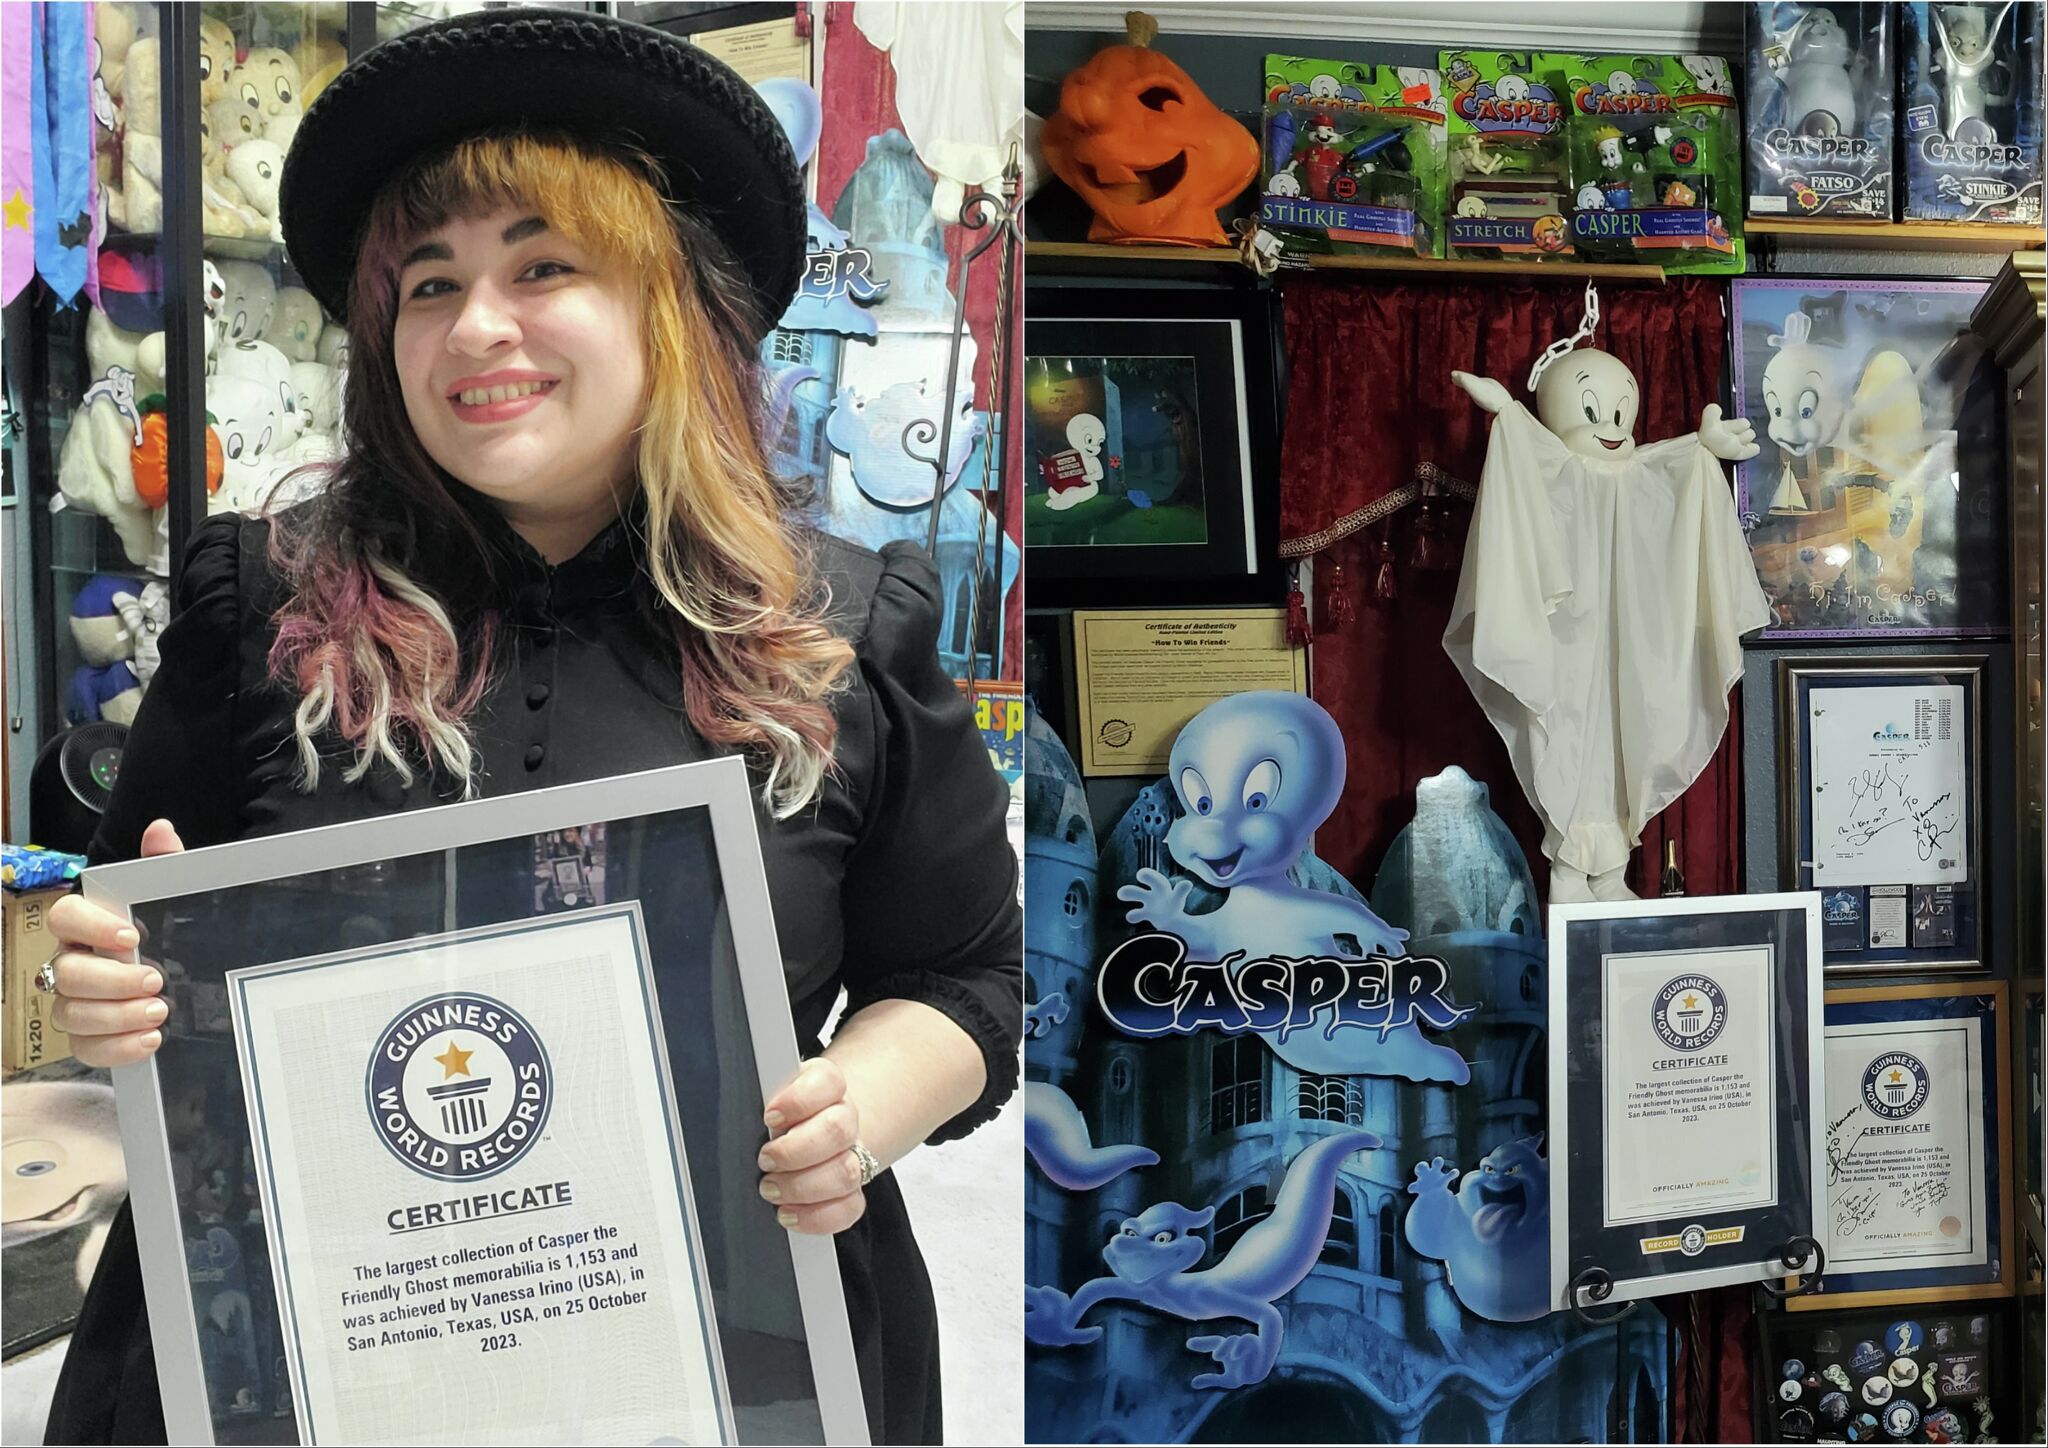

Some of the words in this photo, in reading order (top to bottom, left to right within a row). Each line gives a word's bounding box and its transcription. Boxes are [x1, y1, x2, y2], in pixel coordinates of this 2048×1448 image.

[1454, 91, 1566, 123] CASPER
[1575, 88, 1679, 115] CASPER
[1765, 128, 1879, 165] CASPER
[1922, 133, 2032, 172] CASPER
[1811, 176, 1854, 189] FATSO
[1966, 183, 2008, 196] STINKIE
[1263, 203, 1348, 228] STINKIE
[1574, 213, 1648, 237] CASPER
[1455, 225, 1526, 239] STRETCH
[1193, 622, 1237, 630] Authenticity
[26, 903, 40, 929] 215
[1098, 930, 1482, 1045] CASPER
[1662, 978, 1718, 1001] GUINNESS
[386, 1003, 519, 1063] GUINNESS
[1656, 1009, 1682, 1046] WORLD
[1686, 1005, 1724, 1048] RECORDS
[29, 1019, 43, 1063] 1x20
[1652, 1055, 1729, 1070] CERTIFICATE
[1870, 1055, 1920, 1075] GUINNESS
[1628, 1090, 1654, 1100] Friendly
[1655, 1089, 1674, 1097] Ghost
[1675, 1086, 1713, 1096] memorabilia
[1721, 1083, 1738, 1091] 1,153
[1635, 1082, 1647, 1090] The
[1648, 1080, 1671, 1089] largest
[1672, 1077, 1703, 1086] collection
[1703, 1075, 1711, 1083] of
[1711, 1075, 1733, 1083] Casper
[1628, 1111, 1641, 1119] San
[1718, 1102, 1726, 1110] 25
[1727, 1100, 1752, 1108] October
[1643, 1100, 1671, 1108] achieved
[1672, 1098, 1681, 1106] by
[1681, 1096, 1708, 1105] Vanessa
[1865, 1082, 1889, 1114] WORLD
[1892, 1080, 1926, 1117] RECORDS
[377, 1086, 450, 1168] WORLD
[459, 1062, 542, 1171] RECORDS
[1863, 1123, 1931, 1135] CERTIFICATE
[1841, 1159, 1863, 1167] Friendly
[1882, 1156, 1916, 1164] memorabilia
[1858, 1150, 1878, 1159] largest
[1879, 1149, 1906, 1157] collection
[1914, 1147, 1934, 1155] Casper
[1854, 1166, 1879, 1174] achieved
[1652, 1182, 1694, 1193] OFFICIALLY
[1695, 1178, 1730, 1188] AMAZING
[386, 1181, 573, 1230] CERTIFICATE
[1648, 1240, 1679, 1249] RECORD
[1707, 1231, 1738, 1241] HOLDER
[353, 1264, 383, 1282] The
[385, 1255, 439, 1278] largest
[441, 1244, 515, 1266] collection
[518, 1237, 534, 1254] of
[538, 1232, 590, 1253] Casper
[593, 1225, 619, 1241] the
[341, 1284, 402, 1307] Friendly
[405, 1277, 449, 1296] Ghost
[452, 1260, 545, 1289] memorabilia
[548, 1258, 562, 1272] is
[565, 1248, 607, 1269] 1,153
[610, 1243, 639, 1261] and
[343, 1314, 376, 1330] was
[379, 1299, 447, 1323] achieved
[450, 1297, 468, 1316] by
[471, 1285, 536, 1308] Vanessa
[539, 1279, 574, 1296] Irino
[578, 1269, 627, 1294] (USA),
[630, 1267, 646, 1281] in
[347, 1335, 377, 1352] San
[380, 1324, 444, 1347] Antonio,
[446, 1316, 498, 1336] Texas,
[500, 1307, 540, 1326] USA,
[543, 1306, 562, 1319] on
[566, 1299, 585, 1316] 25
[588, 1289, 649, 1312] October
[480, 1333, 523, 1352] 2023.
